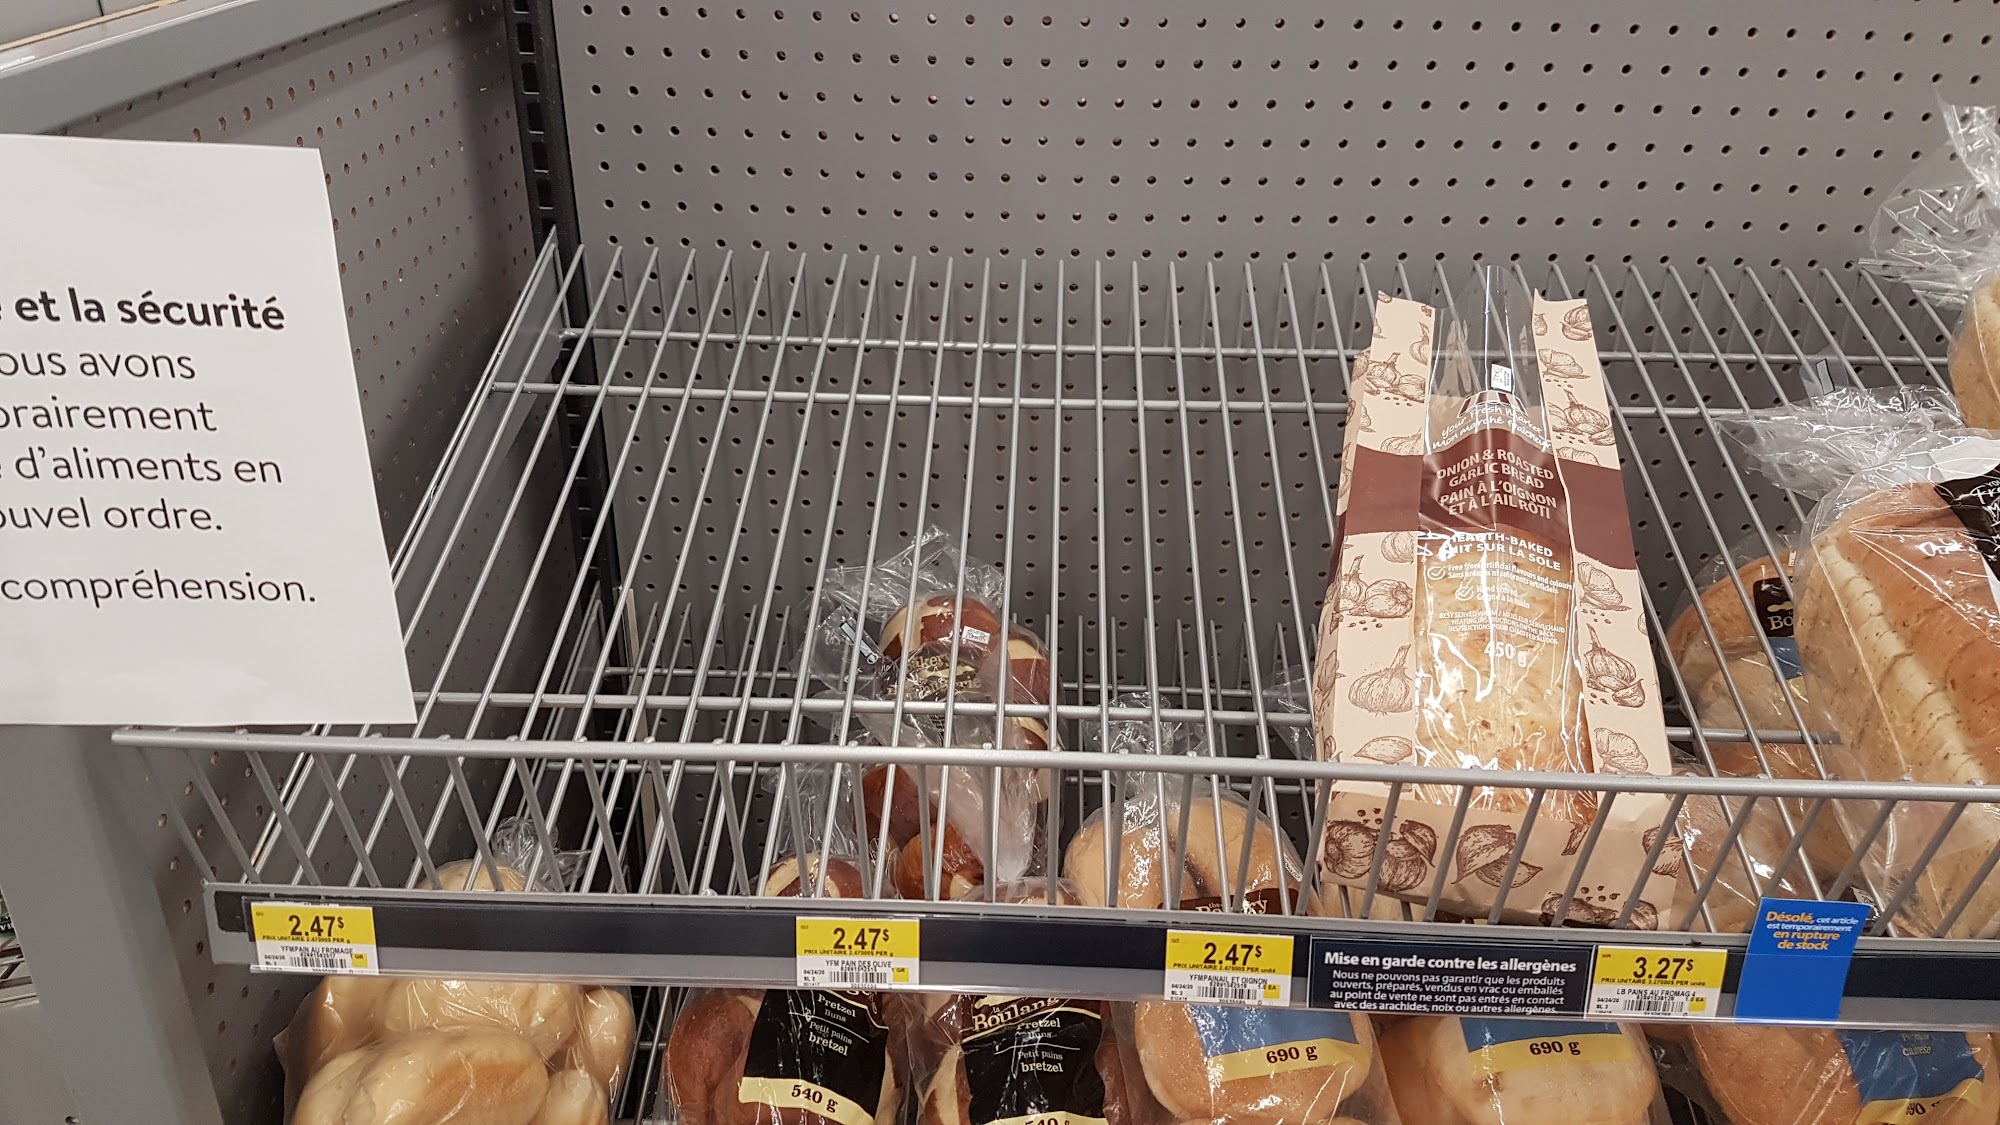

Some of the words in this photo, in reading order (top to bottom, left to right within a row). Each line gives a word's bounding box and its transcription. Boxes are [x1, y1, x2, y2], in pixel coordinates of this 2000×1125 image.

[15, 290, 60, 321] et
[68, 287, 105, 322] la
[117, 290, 285, 331] sécurité
[80, 353, 195, 379] avons
[15, 446, 221, 482] d'aliments
[234, 460, 282, 484] en
[1437, 452, 1480, 479] ONION
[1482, 449, 1495, 461] &
[1497, 449, 1555, 480] ROASTED
[1449, 463, 1499, 487] GARLIC
[1501, 463, 1545, 489] BREAD
[1440, 484, 1475, 507] PAIN
[1477, 481, 1488, 495] À
[1490, 481, 1558, 508] L'OIGNON
[0, 497, 90, 528] uvel
[104, 499, 222, 531] ordre.
[1449, 501, 1466, 515] ET
[1468, 497, 1479, 512] À
[1481, 493, 1518, 508] L'AIL
[1519, 500, 1551, 520] RÔTI
[1476, 543, 1506, 553] SUR
[1509, 545, 1526, 559] LA
[1528, 554, 1562, 571] SOLE
[1447, 571, 1464, 579] Sans
[1537, 574, 1549, 584] and
[1549, 580, 1573, 591] colours
[2, 570, 316, 608] compréhension.
[1484, 641, 1517, 660] 450
[1517, 650, 1528, 668] g
[288, 914, 345, 937] 2.47$
[1765, 911, 1815, 923] Désolé,
[1781, 924, 1853, 932] temporairement
[833, 927, 890, 950] 2.47$
[1777, 940, 1794, 949] de
[1795, 942, 1829, 950] stock
[1790, 931, 1840, 941] rupture
[321, 947, 353, 955] FROMAGE
[1203, 942, 1263, 965] 2.47$
[825, 959, 840, 967] YFM
[1324, 952, 1360, 966] Mise
[1361, 956, 1380, 966] en
[1381, 955, 1426, 970] garde
[1427, 957, 1477, 969] contre
[1477, 957, 1498, 970] les
[1500, 958, 1577, 975] allergènes
[1633, 957, 1694, 979] 3.27$
[1332, 970, 1360, 980] Nous
[1361, 972, 1375, 980] ne
[1375, 973, 1420, 983] pouvons
[1421, 974, 1440, 984] pas
[1441, 974, 1483, 985] garantir
[1484, 976, 1505, 985] que
[1506, 975, 1520, 984] les
[1522, 976, 1566, 986] produits
[1332, 981, 1374, 990] ouverts,
[1375, 981, 1423, 992] préparés,
[1424, 983, 1462, 993] vendus
[1464, 985, 1477, 993] en
[1479, 985, 1500, 993] vrac
[1502, 985, 1516, 994] ou
[1517, 985, 1564, 995] emballés
[817, 994, 857, 1018] Pretzel
[1329, 991, 1343, 999] au
[1344, 990, 1372, 1000] point
[1373, 991, 1387, 1000] de
[1388, 993, 1418, 1001] vente
[1419, 994, 1432, 1002] ne
[1434, 994, 1456, 1002] sont
[1458, 995, 1476, 1004] pas
[1478, 993, 1509, 1004] entrés
[1511, 996, 1525, 1004] en
[1526, 996, 1565, 1005] contact
[1334, 1001, 1358, 1009] avec
[1359, 1001, 1377, 1010] des
[1379, 1001, 1429, 1012] arachides,
[1431, 1003, 1454, 1012] noix
[1455, 1004, 1469, 1012] ou
[1470, 1004, 1502, 1013] autres
[1504, 1004, 1558, 1016] allergènes.
[824, 1008, 847, 1023] Buns
[1016, 1017, 1060, 1030] Pretzel
[808, 1032, 849, 1056] bretzel
[809, 1021, 830, 1034] Petit
[830, 1029, 853, 1045] pains
[1027, 1031, 1052, 1039] Buns
[1018, 1050, 1040, 1060] Petit
[1041, 1050, 1064, 1060] pains
[1267, 1046, 1300, 1064] 690
[1305, 1045, 1318, 1061] g
[1529, 1041, 1563, 1056] 690
[1568, 1041, 1581, 1056] g
[1021, 1061, 1064, 1073] bretzel
[791, 1084, 823, 1104] 540
[826, 1098, 838, 1113] g
